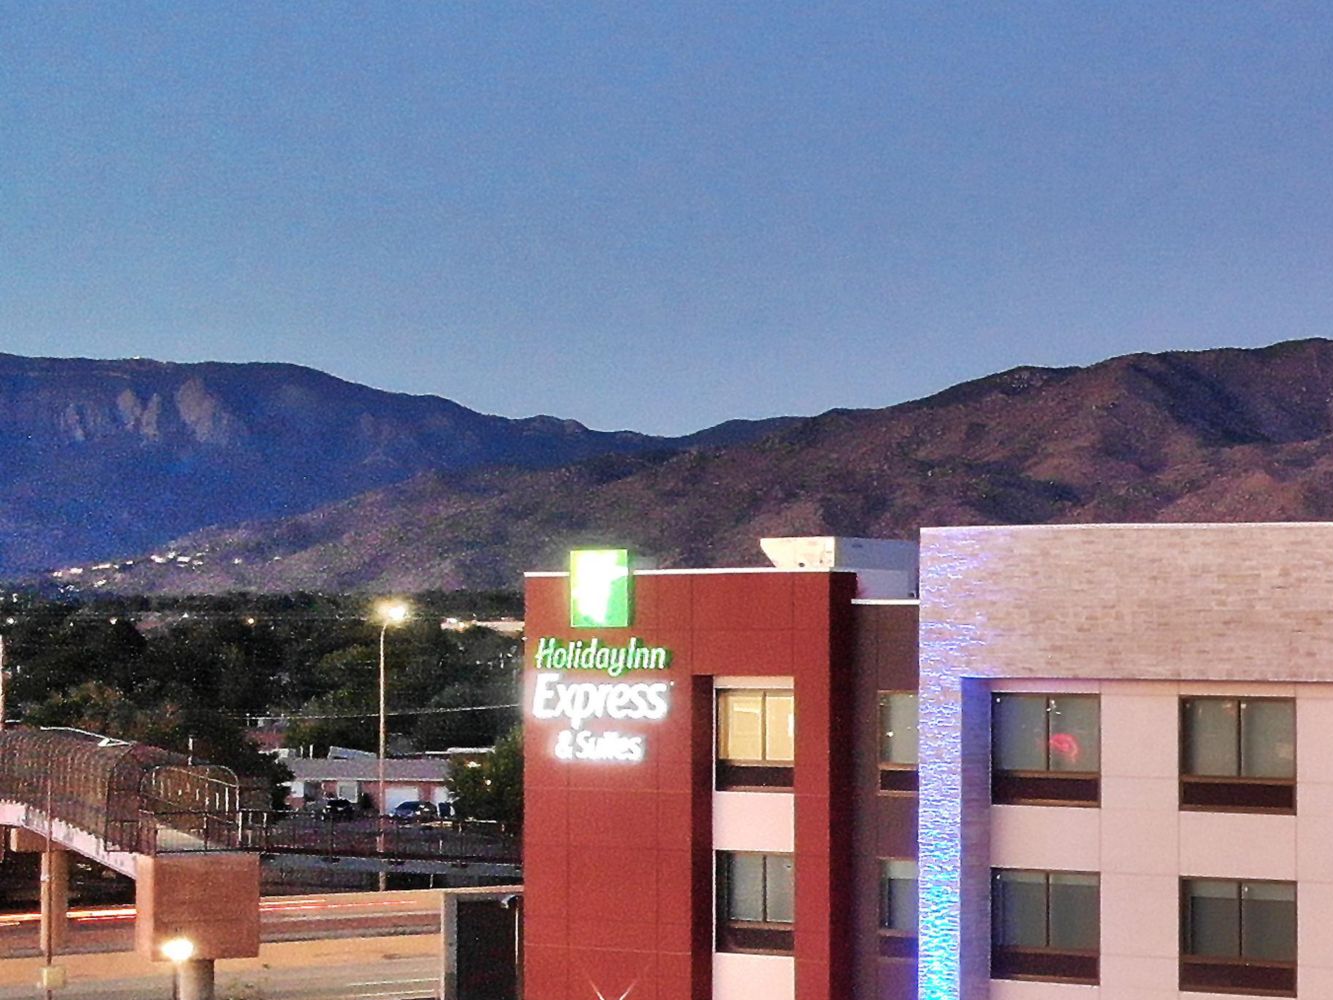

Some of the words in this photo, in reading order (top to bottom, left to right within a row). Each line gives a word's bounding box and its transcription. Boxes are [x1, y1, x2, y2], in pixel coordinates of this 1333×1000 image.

[532, 672, 670, 730] Express
[554, 729, 573, 761] &
[575, 731, 644, 762] Suites
